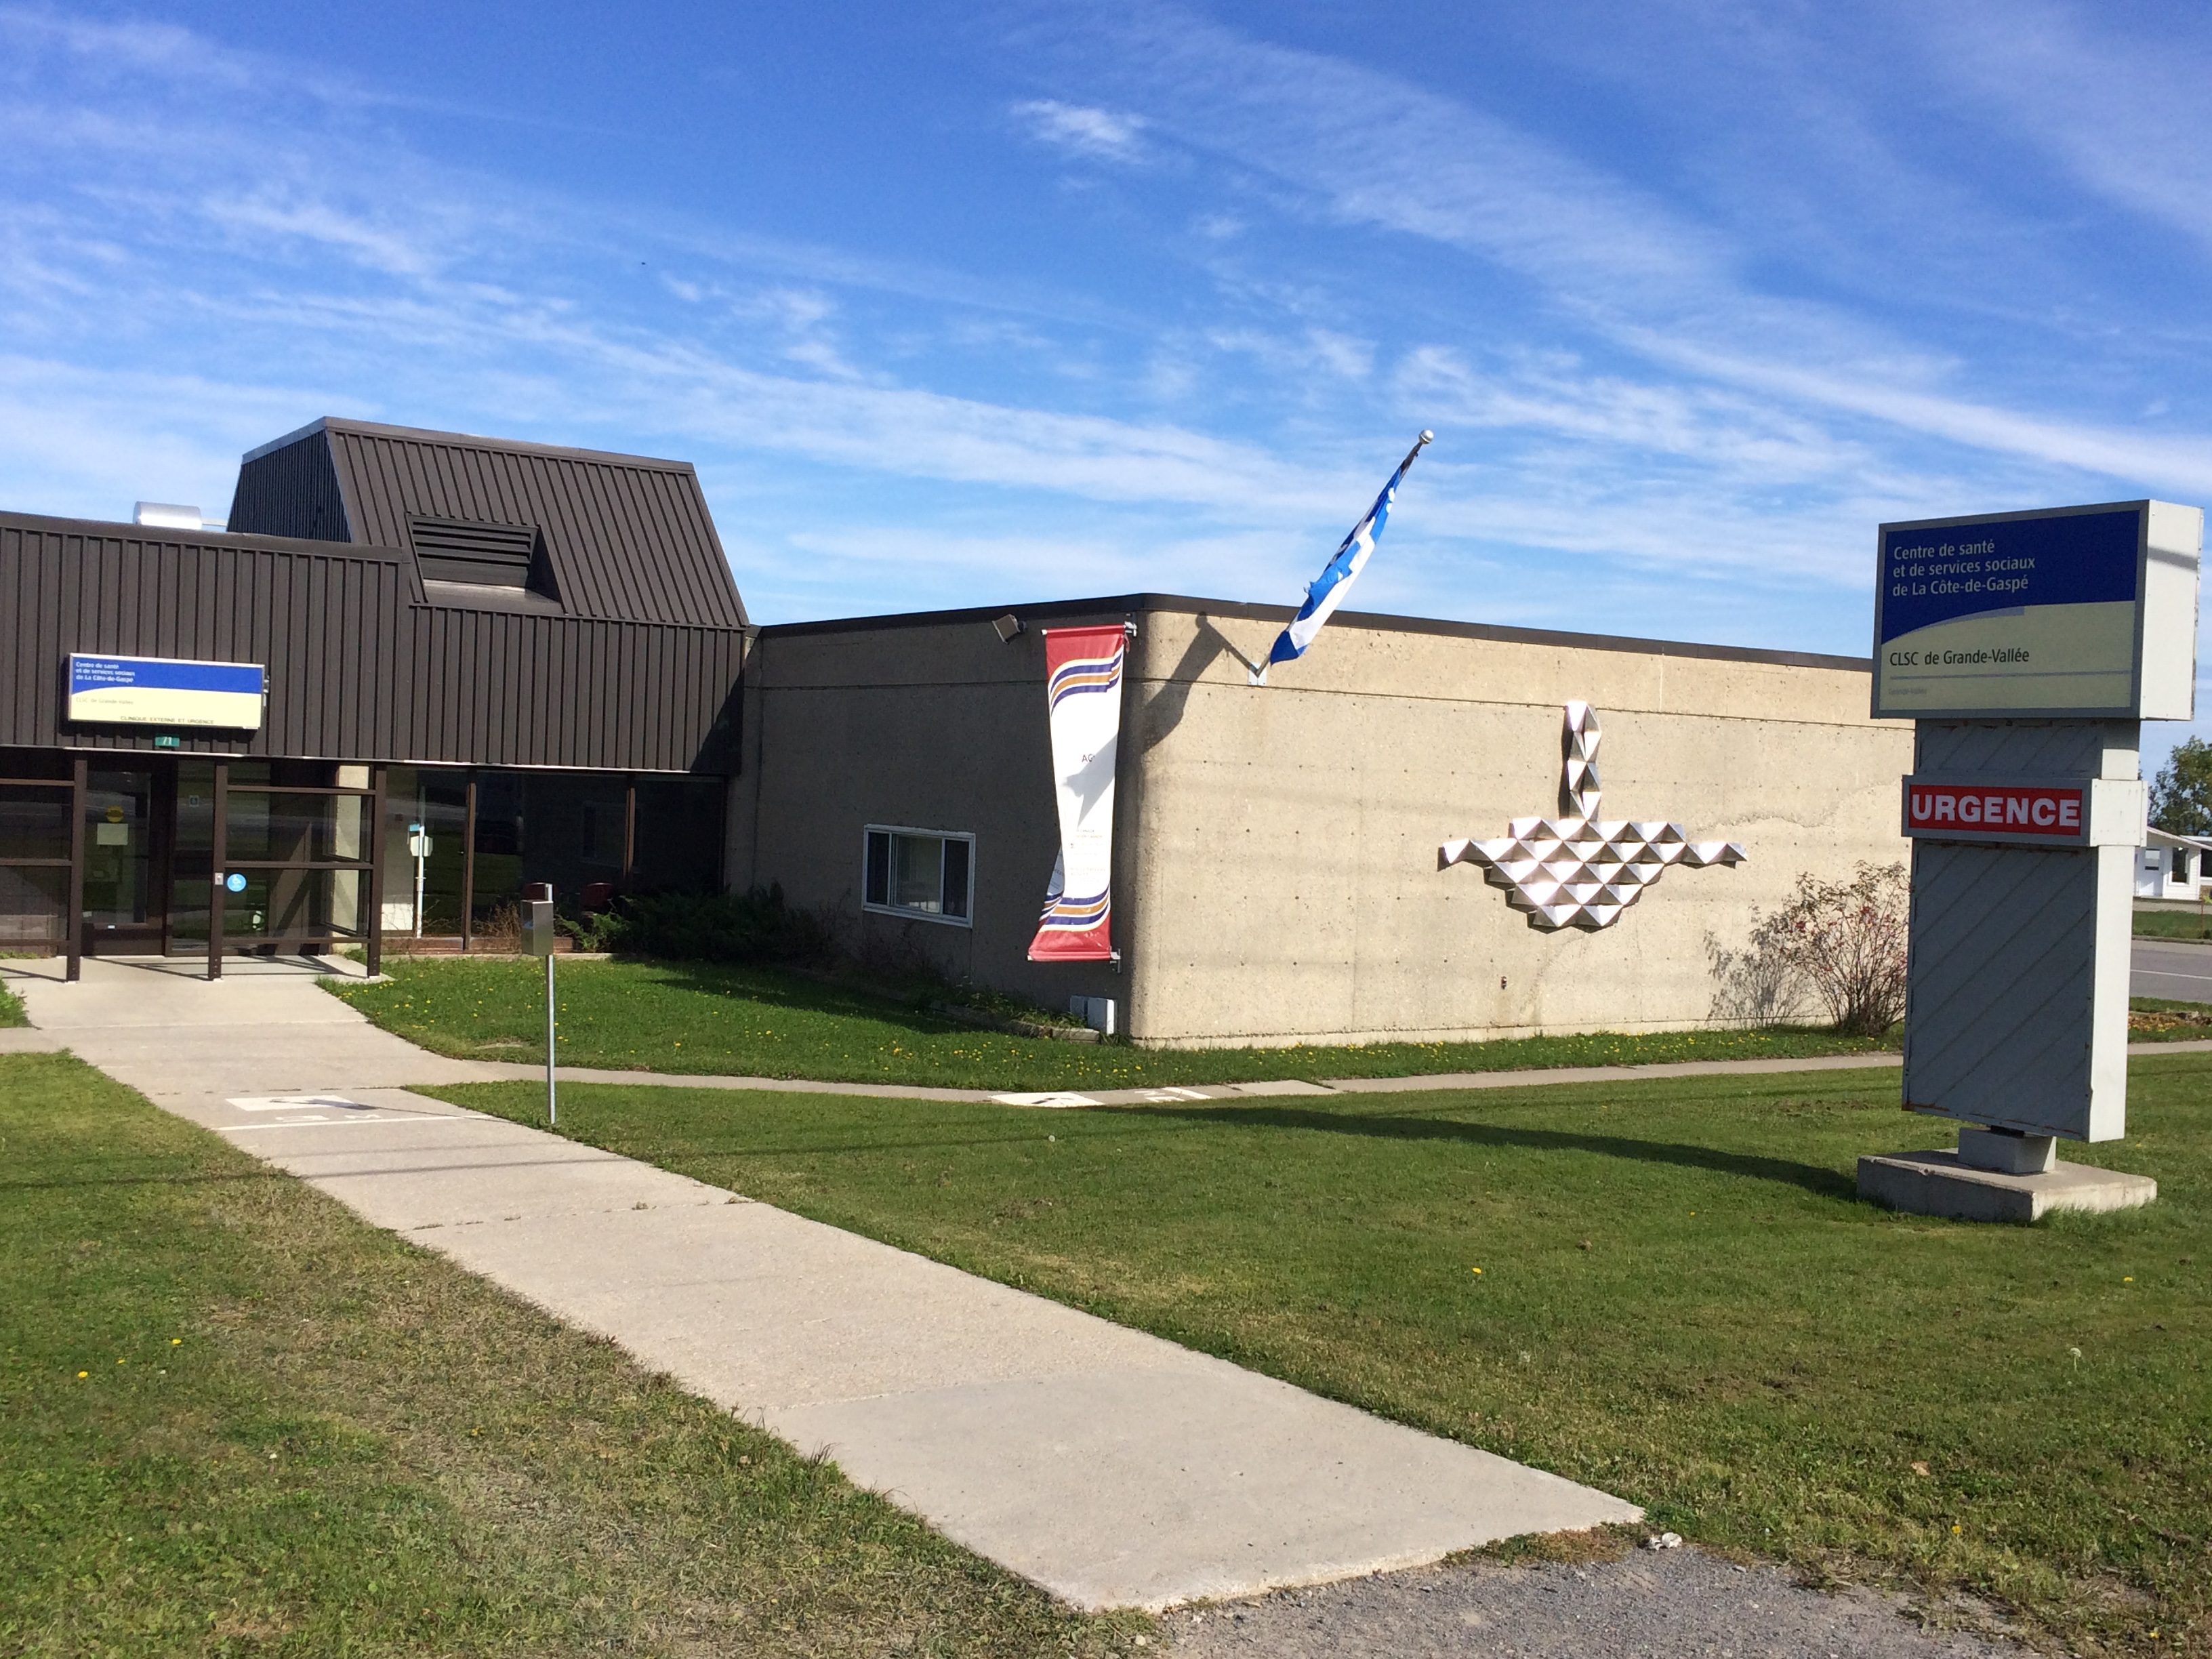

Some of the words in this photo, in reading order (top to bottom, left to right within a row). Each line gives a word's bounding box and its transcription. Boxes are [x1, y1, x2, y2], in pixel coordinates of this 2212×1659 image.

[1893, 546, 1935, 560] Centre
[1939, 544, 1955, 557] de
[1959, 539, 1995, 555] santé
[1893, 564, 1906, 577] et
[1909, 563, 1925, 576] de
[1929, 560, 1980, 575] services
[1985, 556, 2036, 571] sociaux
[1893, 583, 1908, 596] de
[1912, 582, 1926, 595] La
[1931, 575, 2029, 594] Côte-de-Gaspé
[1889, 652, 1919, 666] CLSC
[1925, 651, 1940, 665] de
[1943, 647, 2030, 665] Grande-Vallée
[1912, 794, 2081, 827] URGENCE
